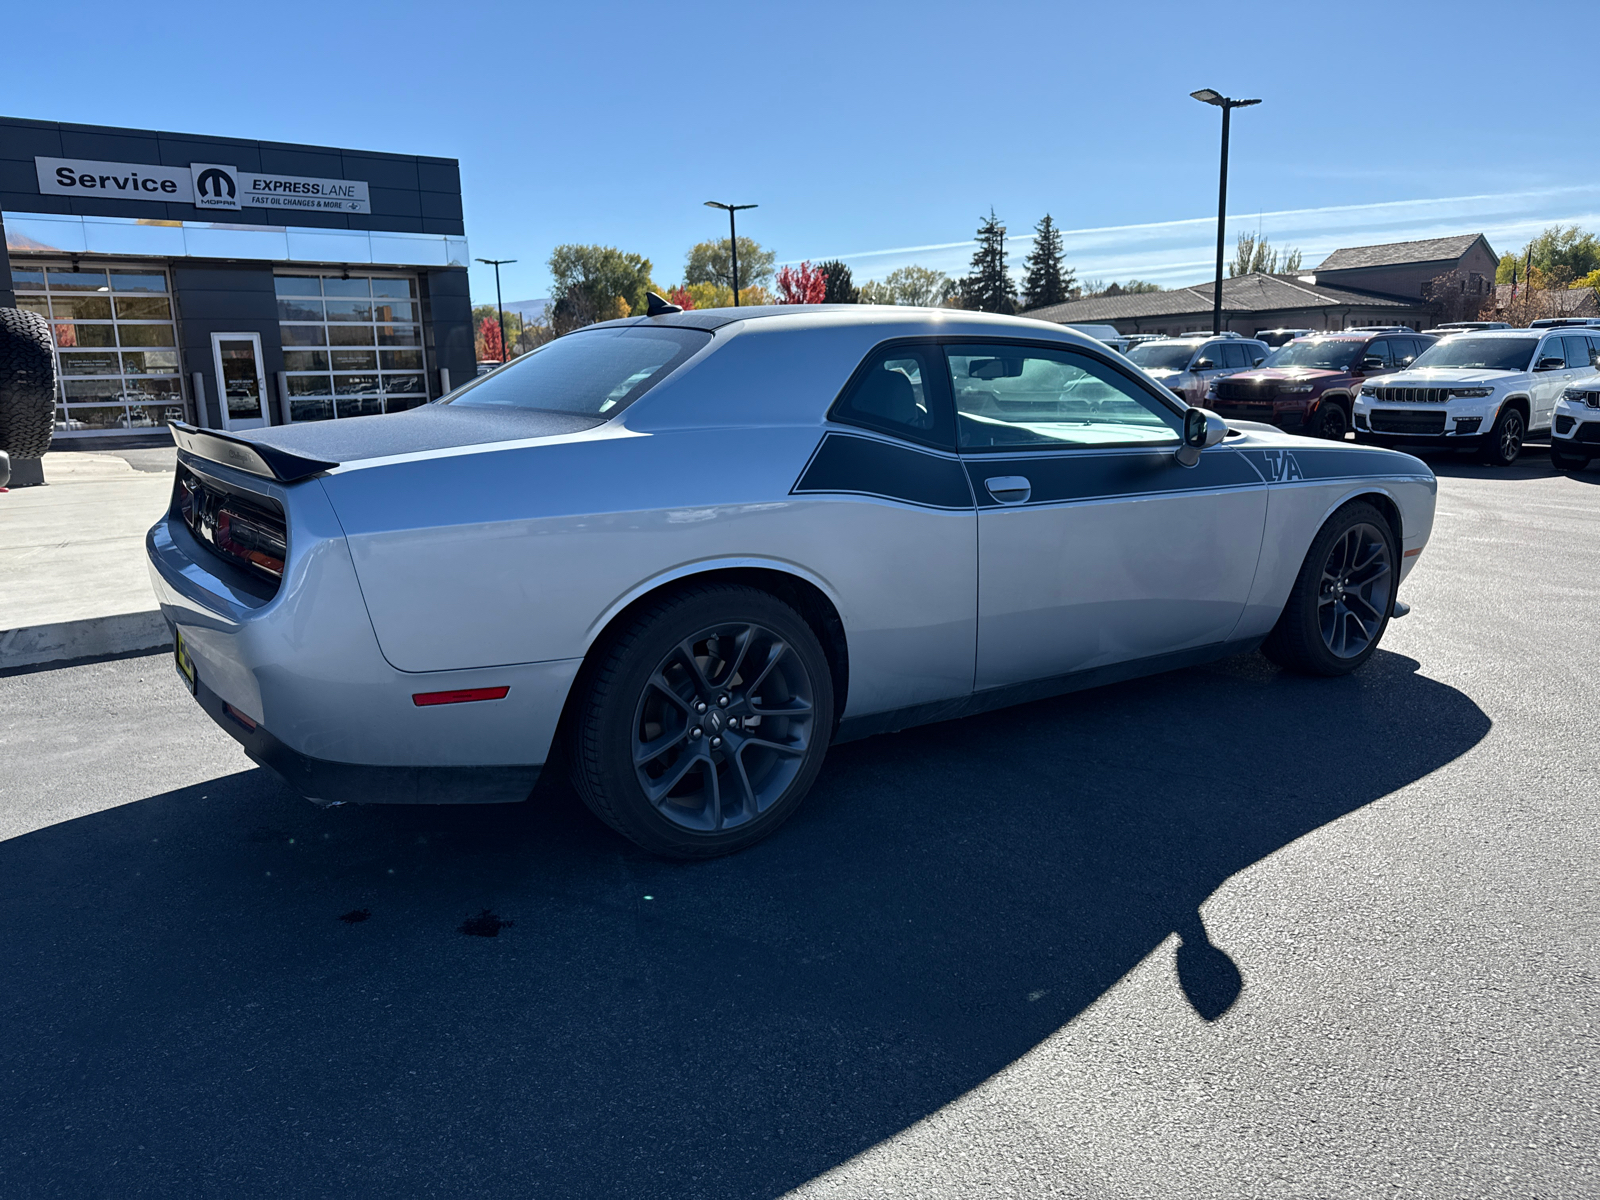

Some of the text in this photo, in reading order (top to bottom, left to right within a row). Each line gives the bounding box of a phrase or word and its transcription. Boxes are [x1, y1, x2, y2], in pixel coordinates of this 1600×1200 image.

[55, 166, 178, 194] Service
[201, 198, 236, 206] MOPAR
[251, 196, 343, 209] FAST OIL CHANGES & MORE
[1263, 450, 1304, 482] T/A
